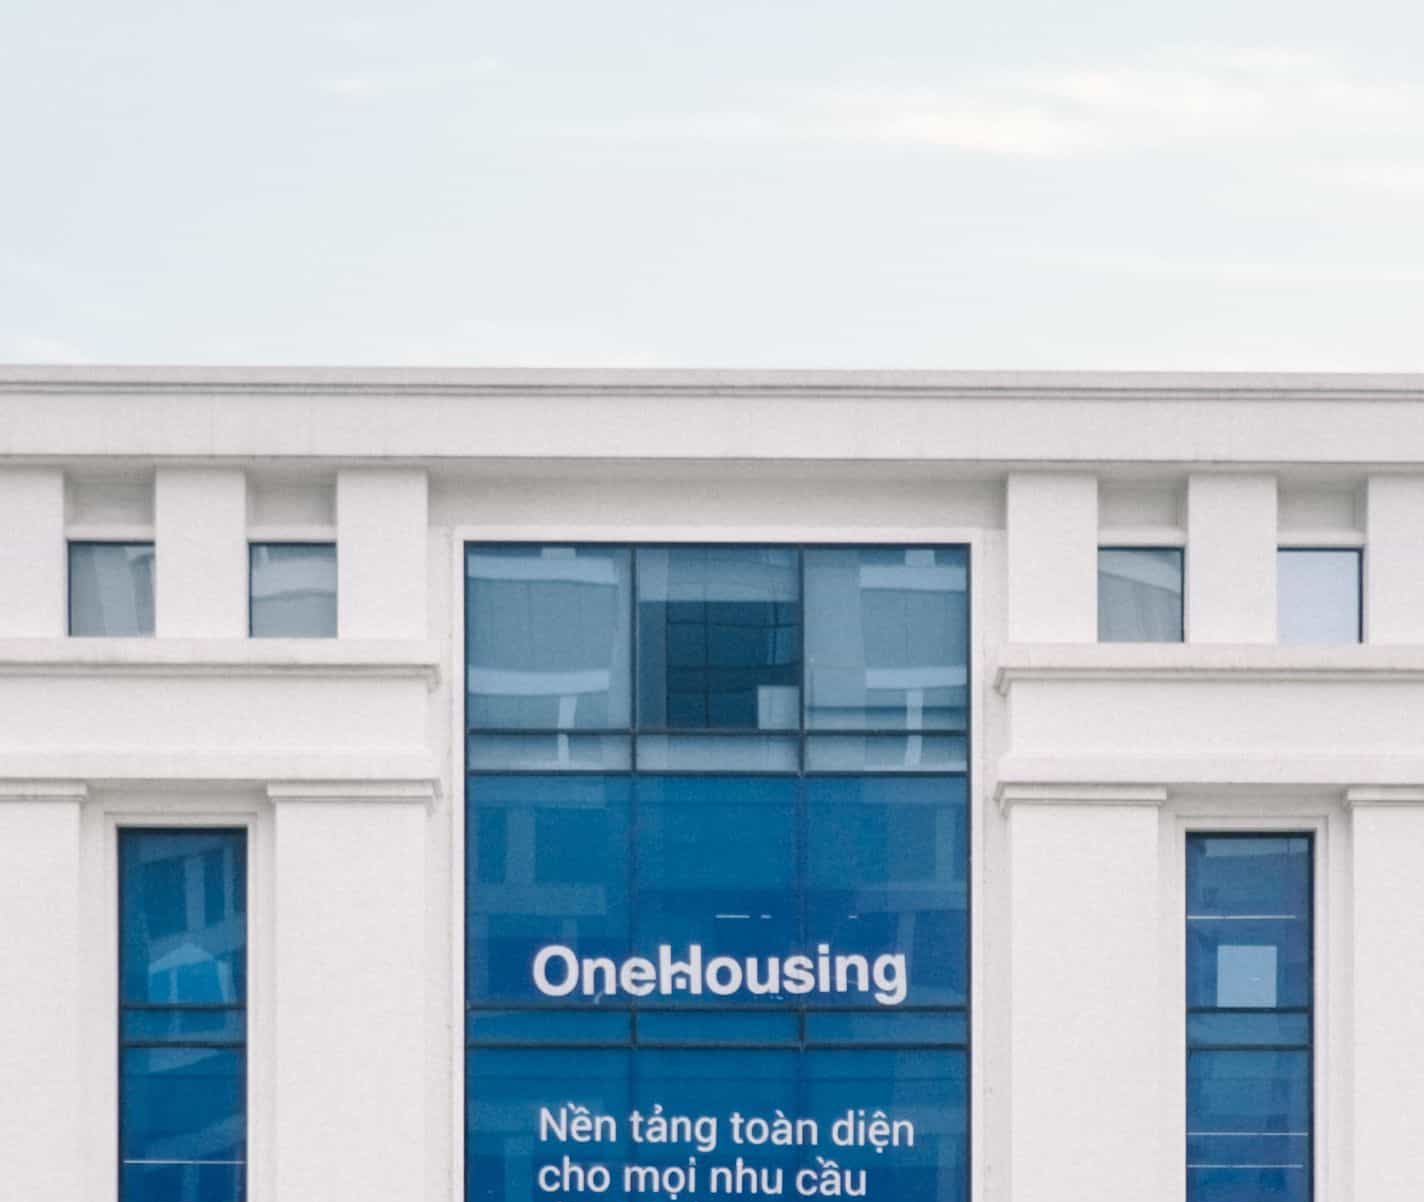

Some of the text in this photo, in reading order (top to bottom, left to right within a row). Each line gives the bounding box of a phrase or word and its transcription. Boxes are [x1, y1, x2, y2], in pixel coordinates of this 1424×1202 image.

[532, 943, 908, 1006] OneHousing
[539, 1103, 915, 1154] Nền tảng toàn diện
[538, 1155, 866, 1200] cho mọi nhu cầu
